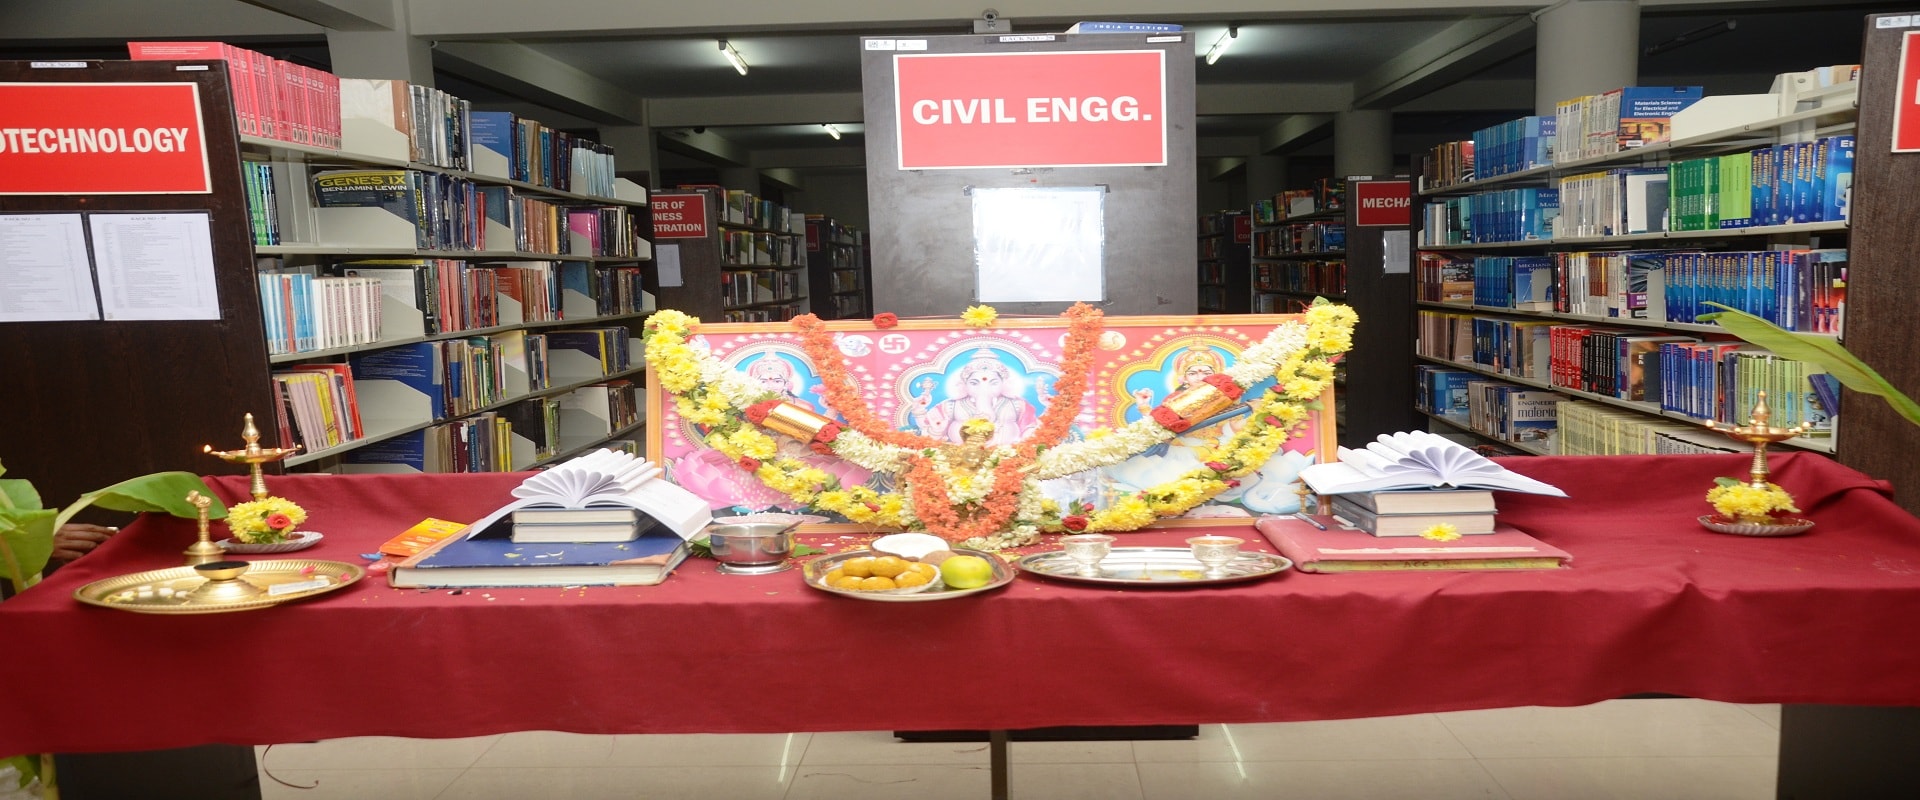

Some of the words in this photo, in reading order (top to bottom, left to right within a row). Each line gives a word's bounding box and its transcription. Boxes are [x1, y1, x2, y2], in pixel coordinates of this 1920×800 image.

[912, 98, 1017, 125] CIVIL
[1027, 95, 1152, 123] ENGG.
[320, 176, 382, 187] GENES
[390, 175, 407, 185] IX
[671, 201, 685, 210] OF
